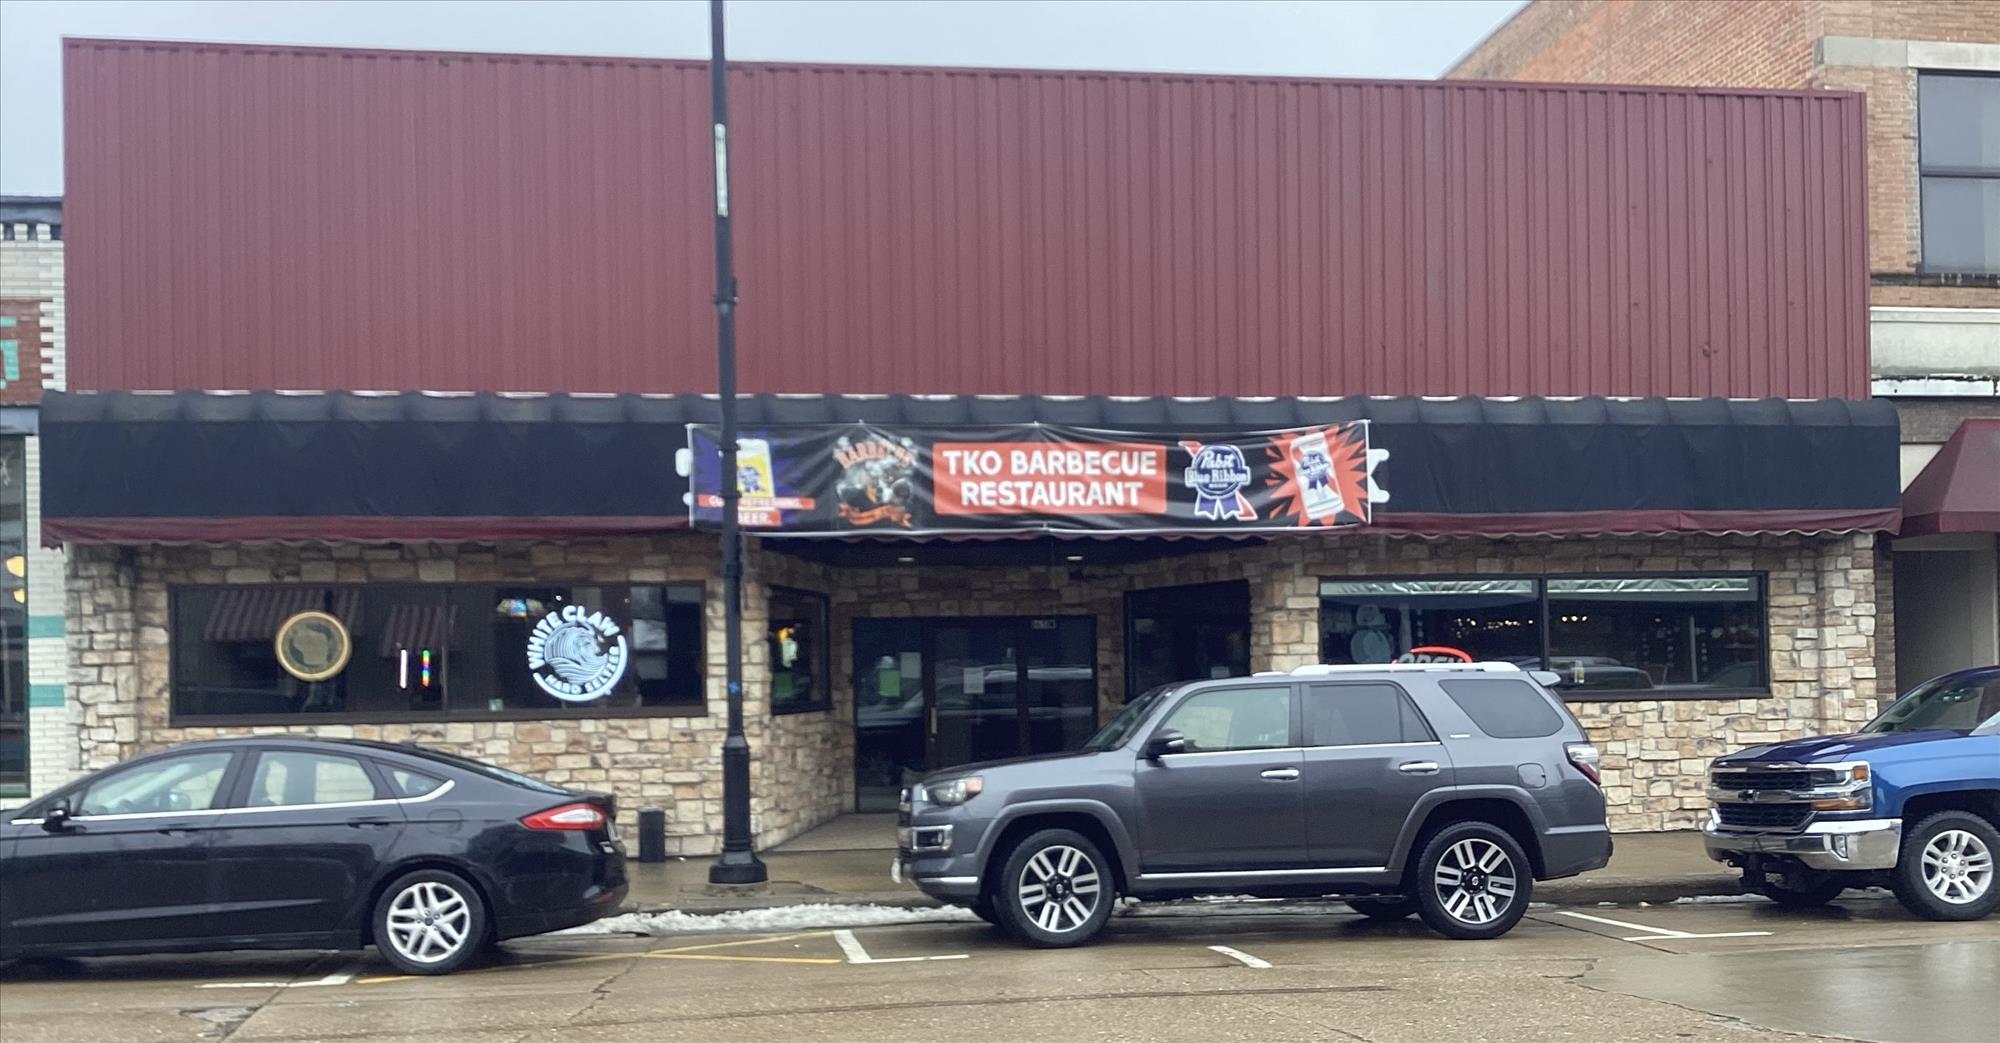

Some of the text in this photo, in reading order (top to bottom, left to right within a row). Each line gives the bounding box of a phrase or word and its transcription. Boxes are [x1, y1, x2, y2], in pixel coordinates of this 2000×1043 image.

[943, 450, 1158, 476] TKO BARBECUE
[1200, 450, 1236, 469] Pabst
[1186, 468, 1247, 483] Blue Ribbon
[960, 480, 1144, 507] RESTAURANT
[526, 605, 620, 670] WHITE CLAW
[544, 646, 620, 695] HARD SELTZER
